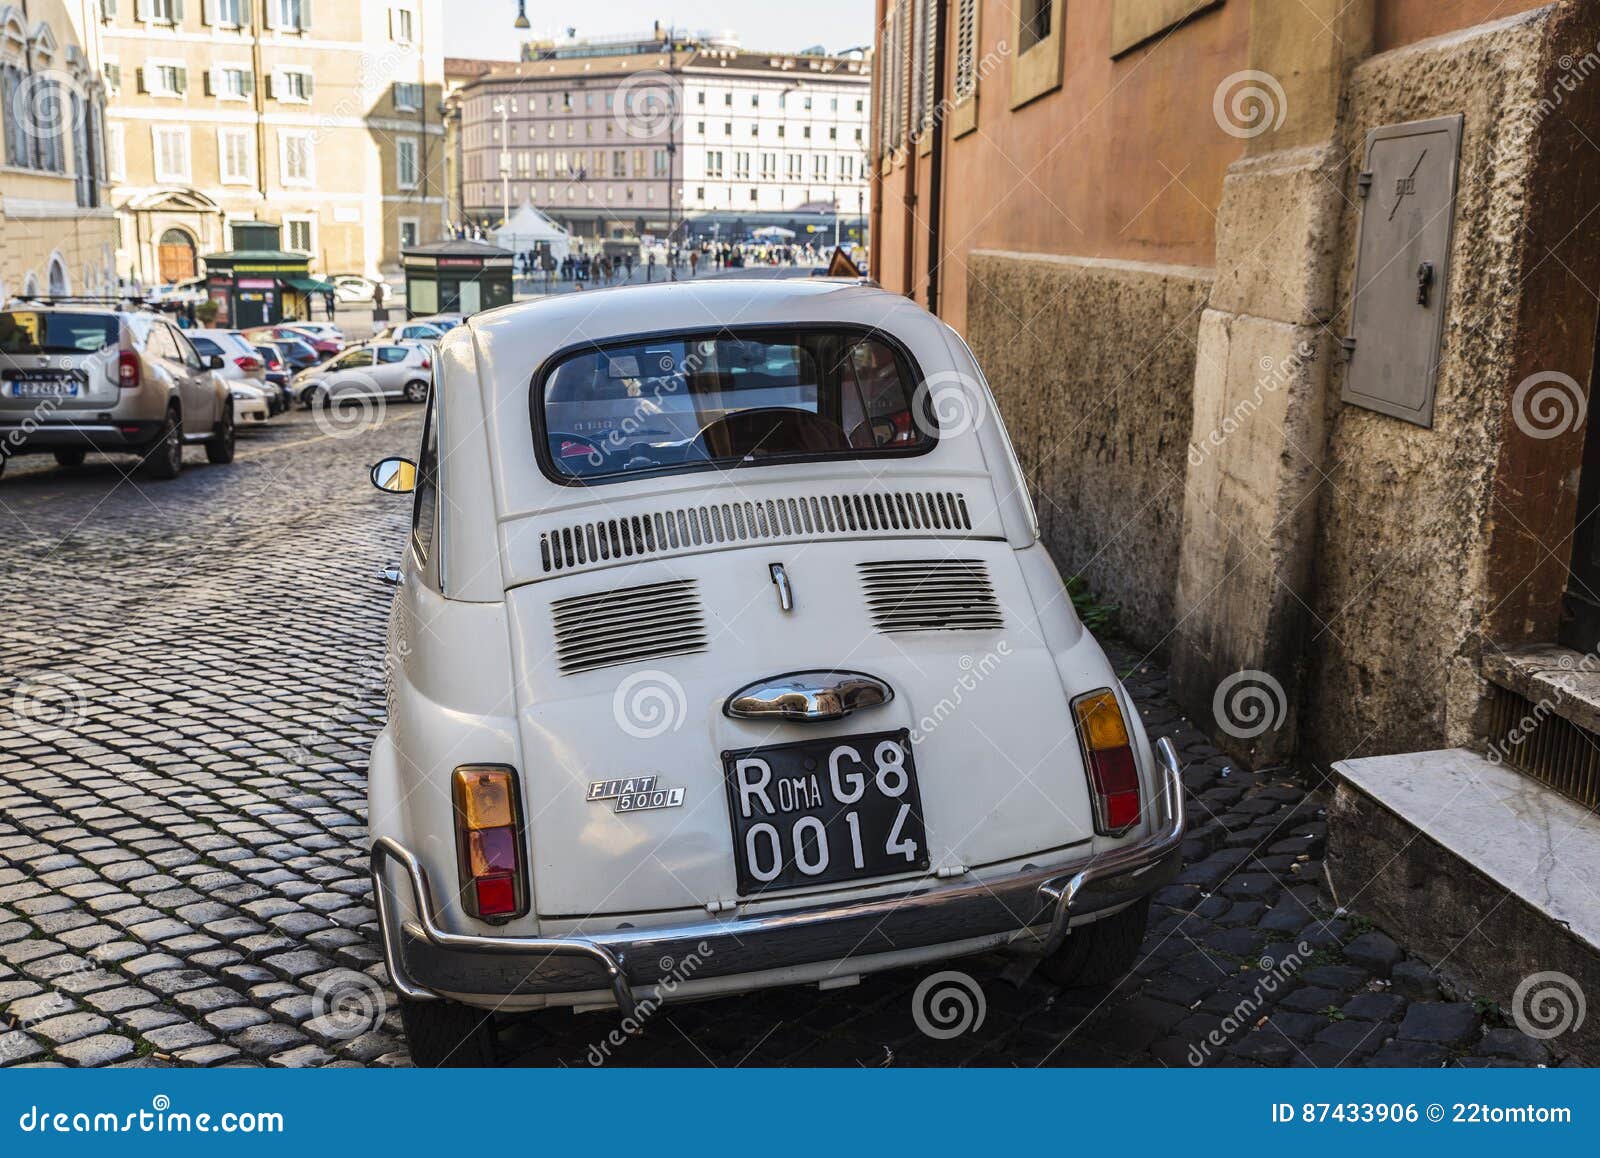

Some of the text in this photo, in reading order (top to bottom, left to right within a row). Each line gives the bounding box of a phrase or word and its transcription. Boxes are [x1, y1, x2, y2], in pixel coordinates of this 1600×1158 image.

[590, 777, 654, 798] FIAT
[828, 740, 909, 804] G8
[617, 788, 683, 811] 500L
[746, 803, 917, 882] 0014
